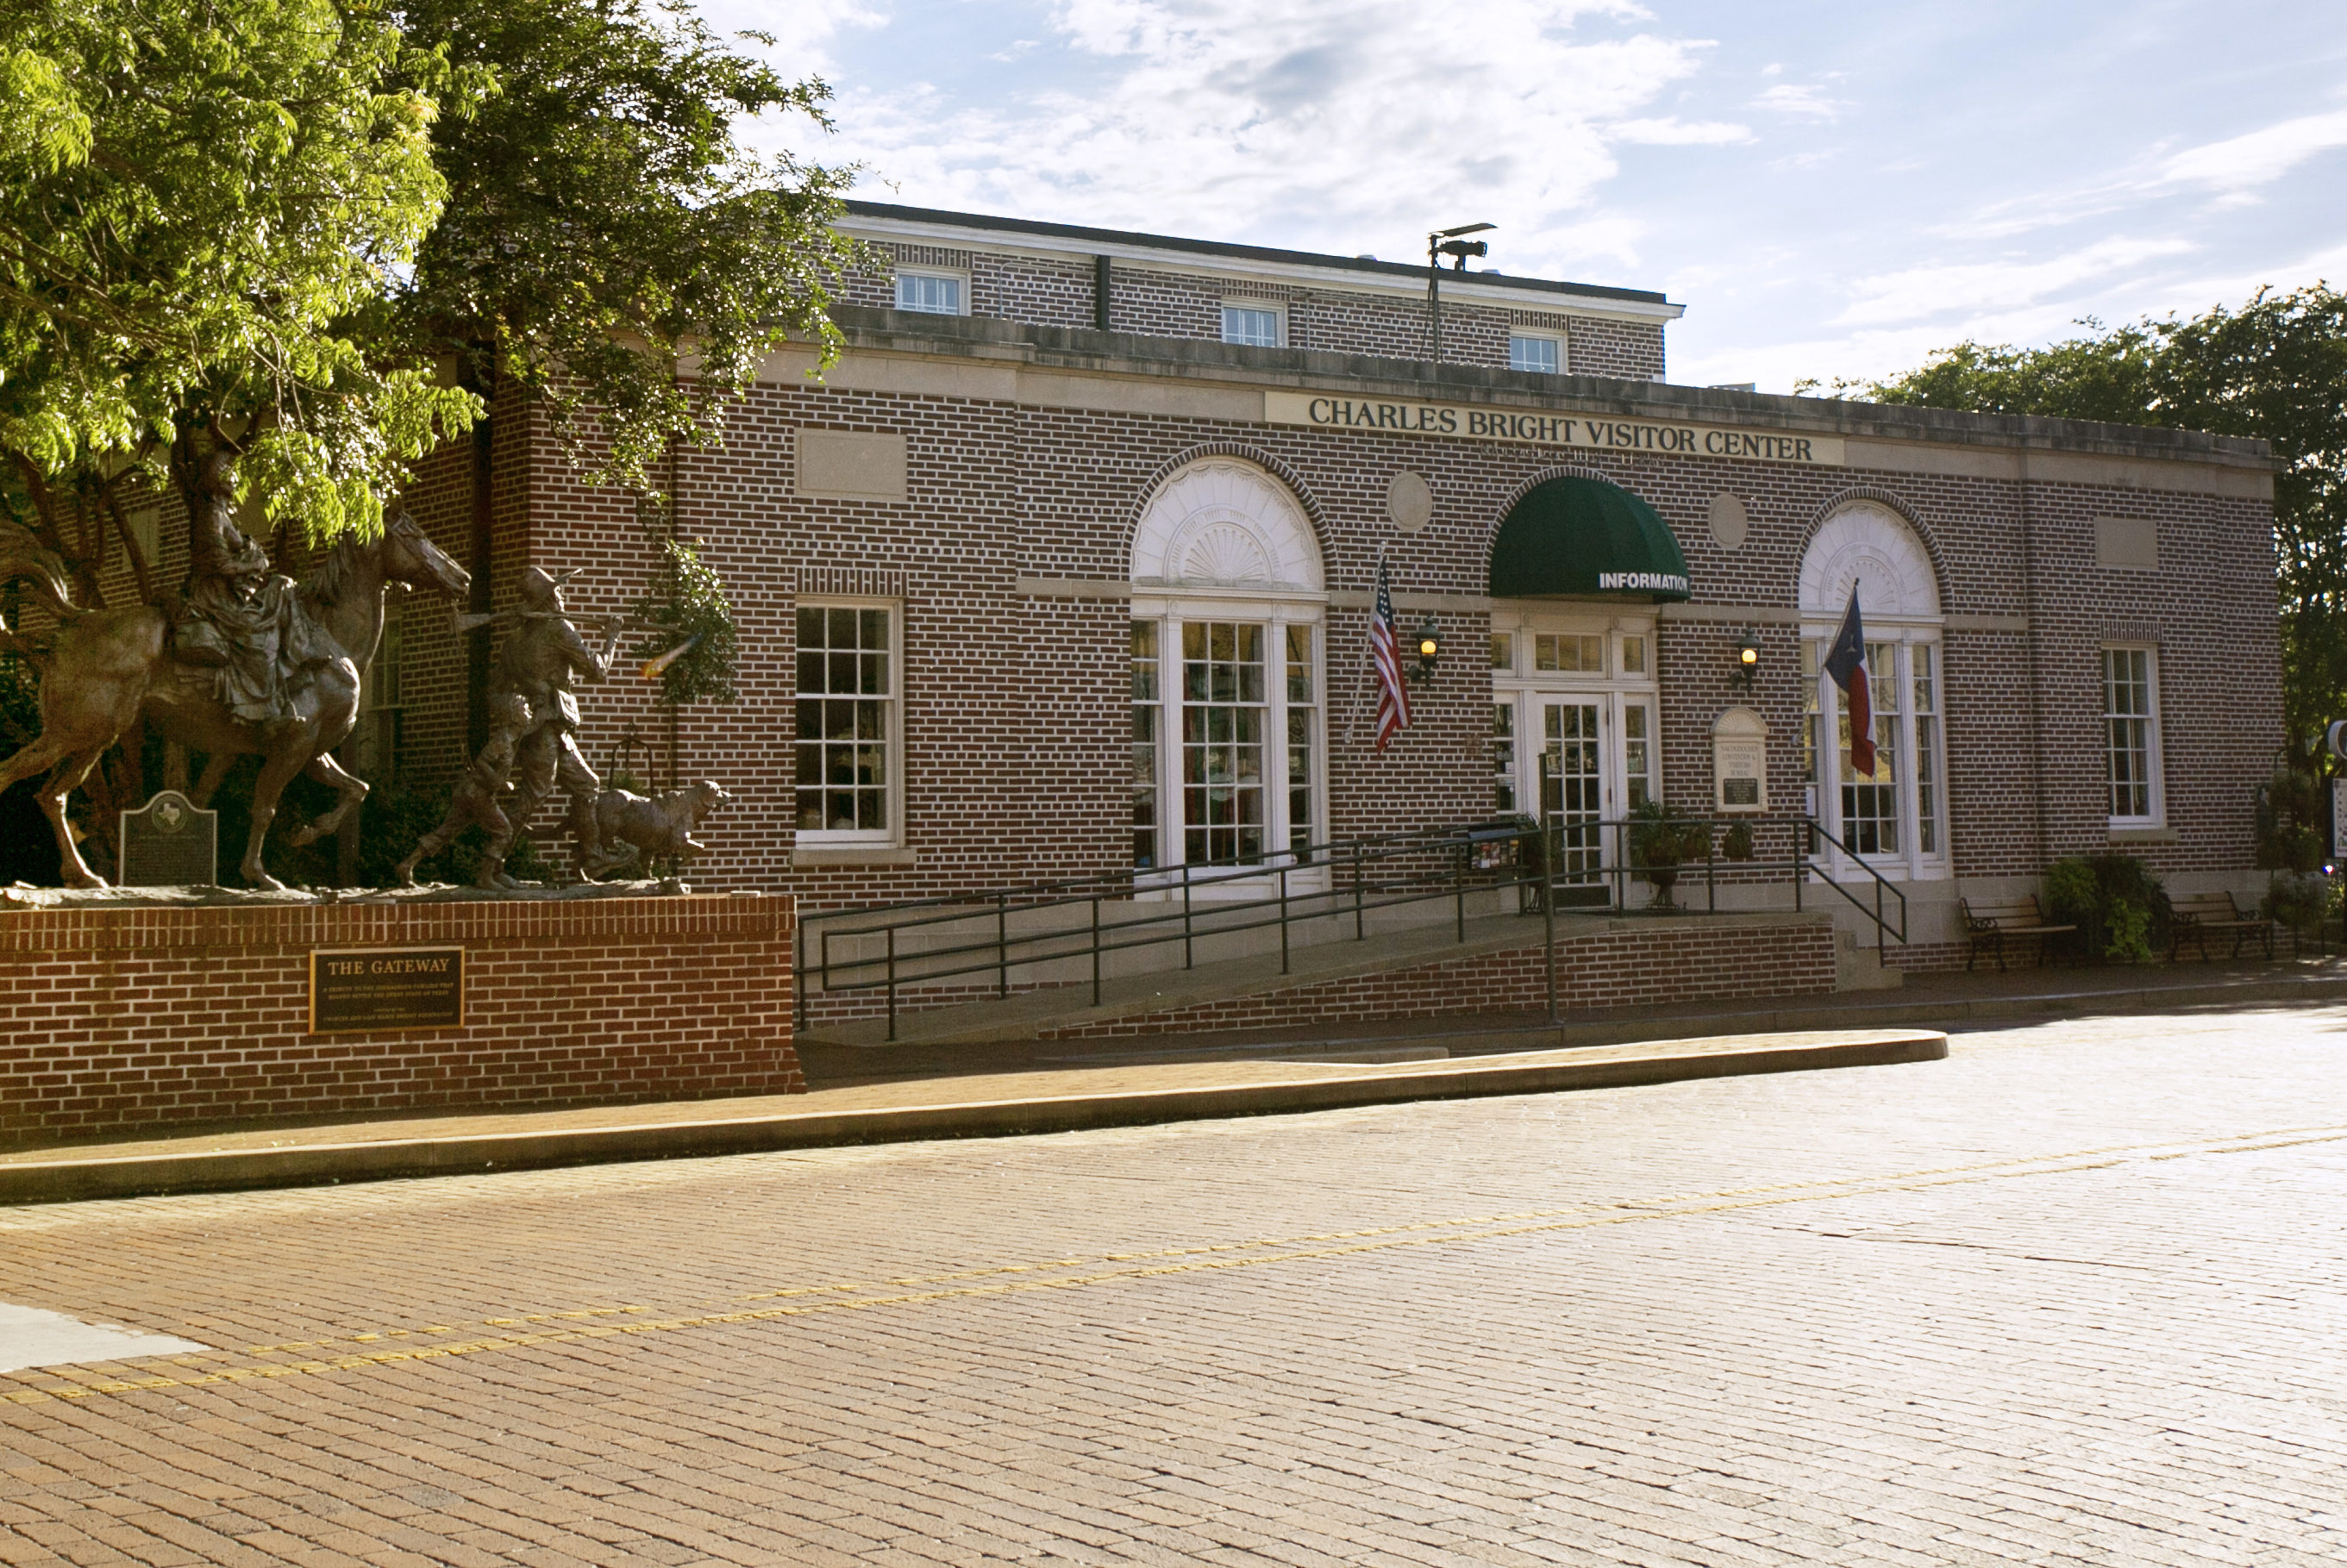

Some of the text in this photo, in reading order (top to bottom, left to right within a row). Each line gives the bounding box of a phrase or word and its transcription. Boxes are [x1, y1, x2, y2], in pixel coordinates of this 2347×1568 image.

[1309, 398, 1457, 434] CHARLES
[1468, 410, 1578, 443] BRIGHT
[1584, 421, 1697, 453] VISITOR
[1705, 430, 1813, 461] CENTER
[1599, 572, 1688, 591] INFORMATION
[328, 959, 449, 975] THE GATEWAY
